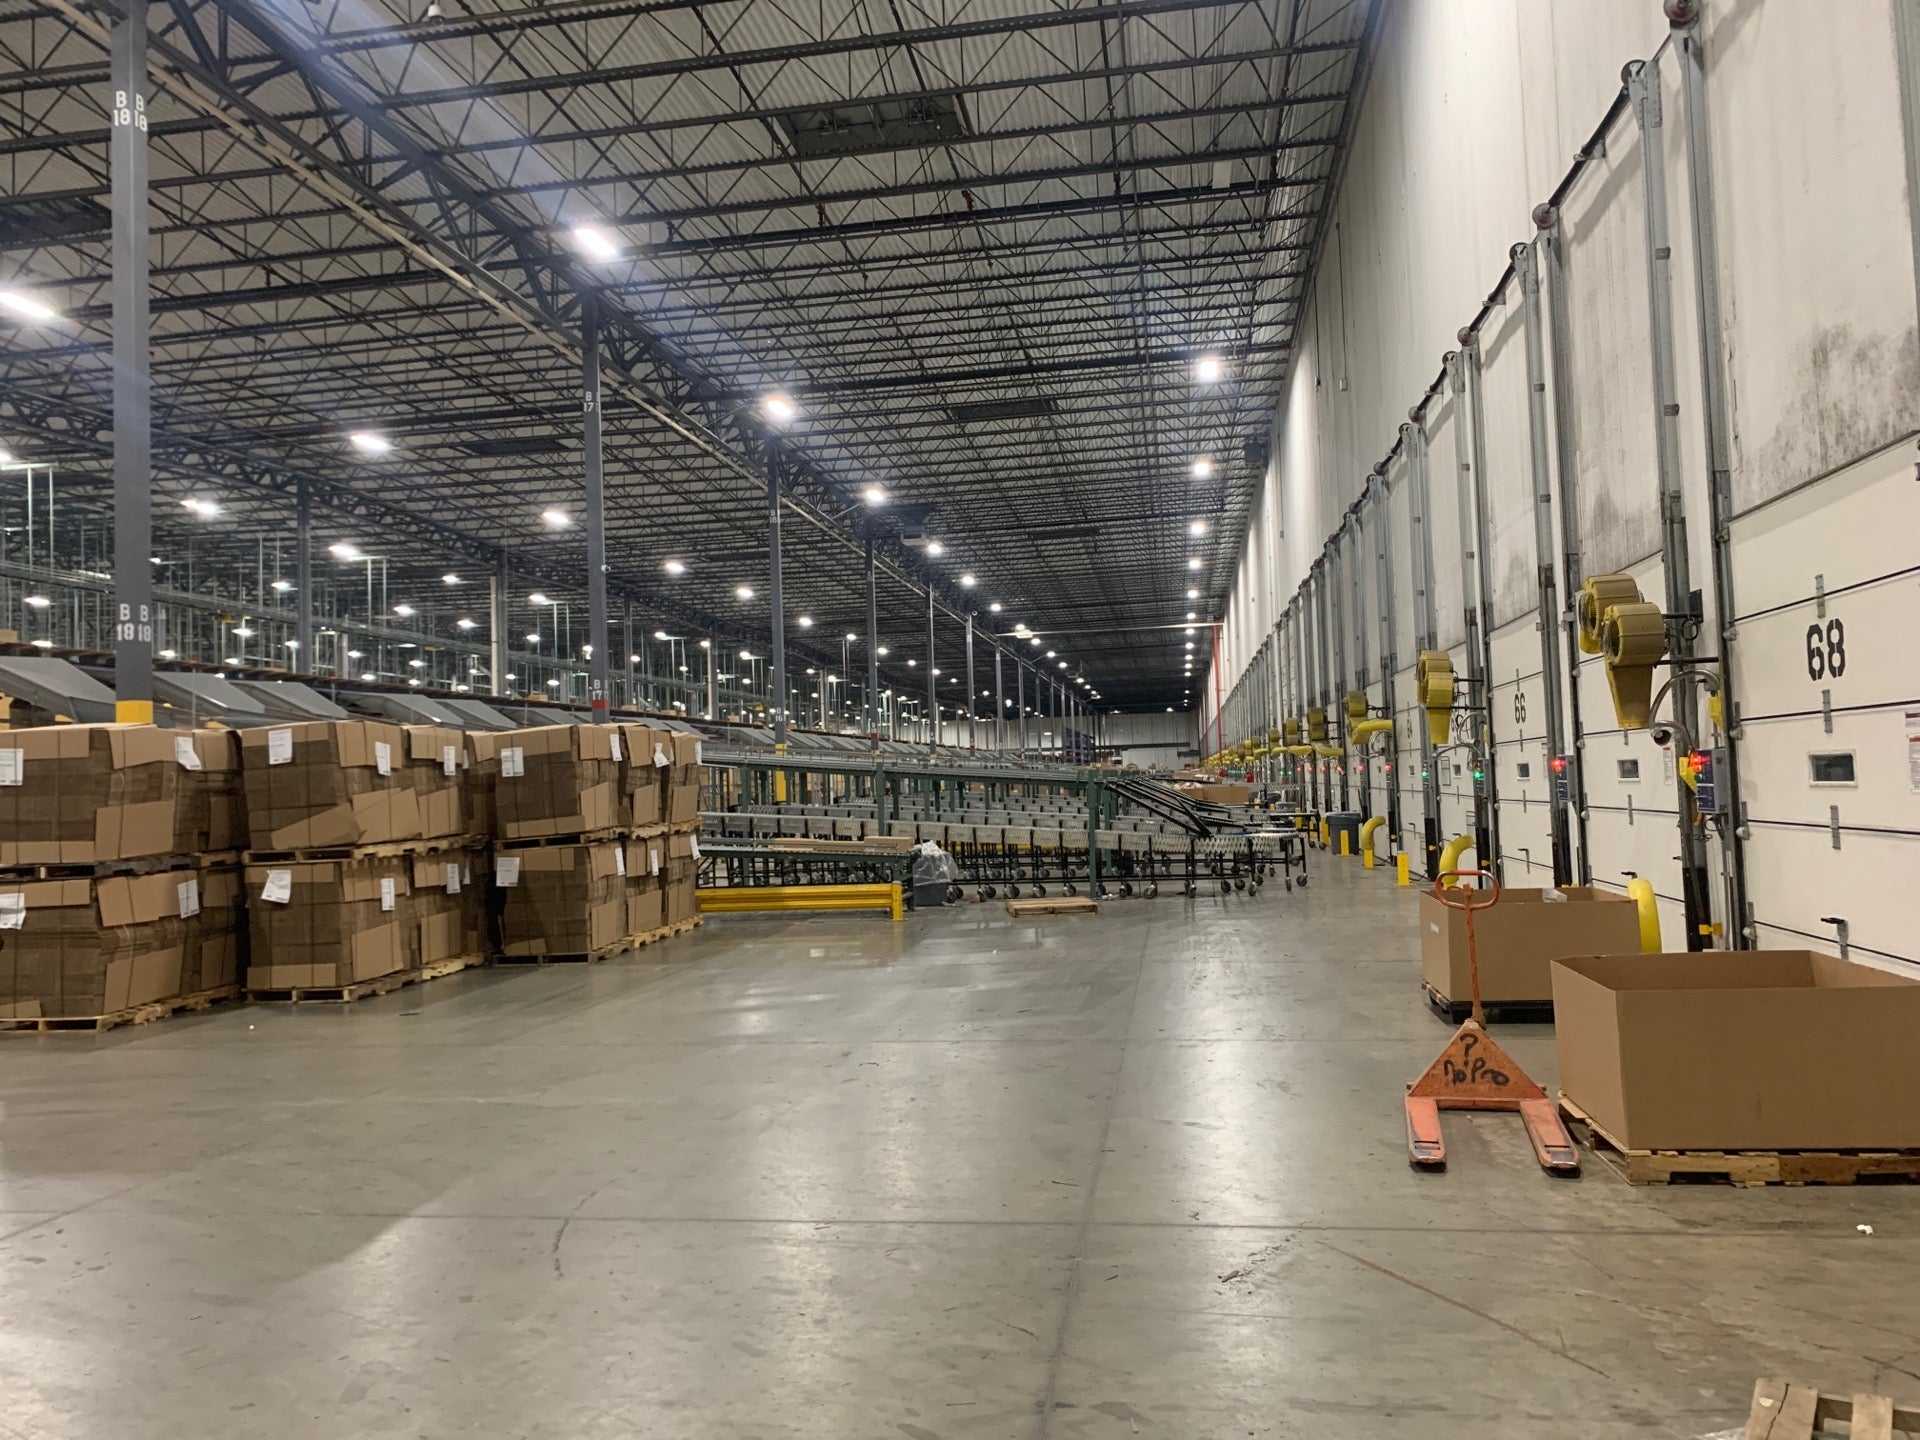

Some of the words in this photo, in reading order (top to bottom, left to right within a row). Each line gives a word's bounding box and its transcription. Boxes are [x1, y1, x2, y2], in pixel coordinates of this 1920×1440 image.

[115, 90, 127, 108] B
[135, 93, 144, 112] B
[113, 108, 131, 126] 18
[134, 109, 148, 131] 18
[585, 391, 592, 401] B
[583, 402, 594, 412] 17
[119, 603, 130, 621] B
[140, 604, 149, 621] B
[116, 622, 134, 641] 18
[138, 623, 151, 642] 18
[1806, 618, 1846, 682] 68
[593, 679, 601, 690] B
[592, 690, 603, 700] 17
[1514, 692, 1526, 724] 66
[1460, 1033, 1478, 1067] ?
